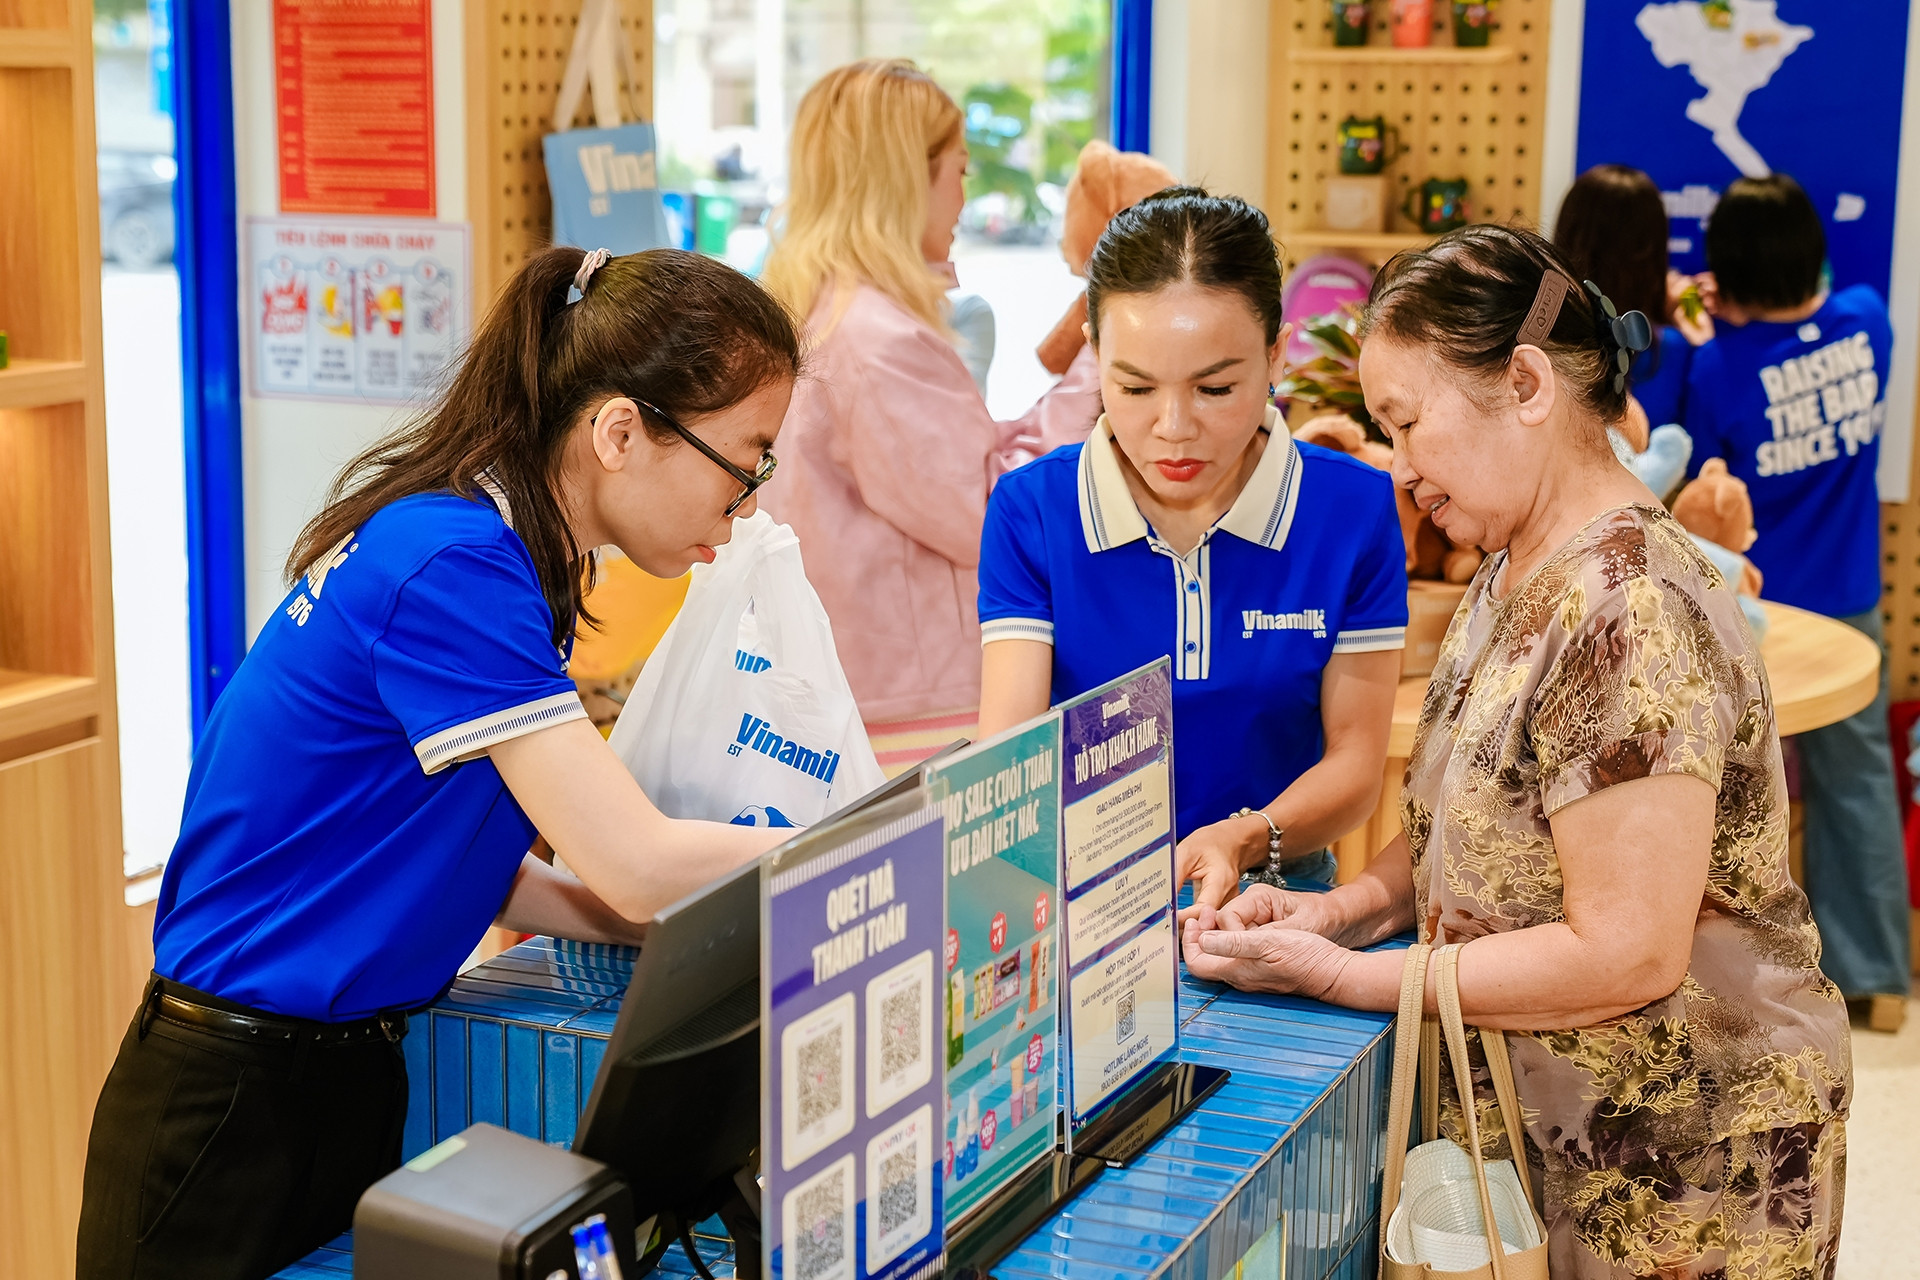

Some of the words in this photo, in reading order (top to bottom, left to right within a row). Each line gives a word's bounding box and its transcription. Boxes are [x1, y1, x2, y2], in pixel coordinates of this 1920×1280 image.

[1759, 331, 1875, 404] RAISING
[1765, 393, 1823, 442] THE
[1756, 424, 1839, 478] SINCE
[1241, 609, 1326, 630] Vinamilk
[727, 744, 743, 757] EST
[736, 712, 840, 784] Vinamil
[1074, 743, 1089, 785] HỖ
[1089, 741, 1108, 777] TRỢ
[1108, 727, 1136, 768] KHÁCH
[1136, 716, 1158, 754] HÀNG
[964, 776, 993, 824] SALE
[994, 756, 1022, 808] CUỐI
[1023, 744, 1053, 794] TUẦN
[971, 820, 993, 867] ĐÃI
[994, 805, 1017, 855] HẾT
[827, 874, 867, 933] QUÉT
[812, 923, 866, 986] THANH
[866, 902, 907, 957] TOÁN
